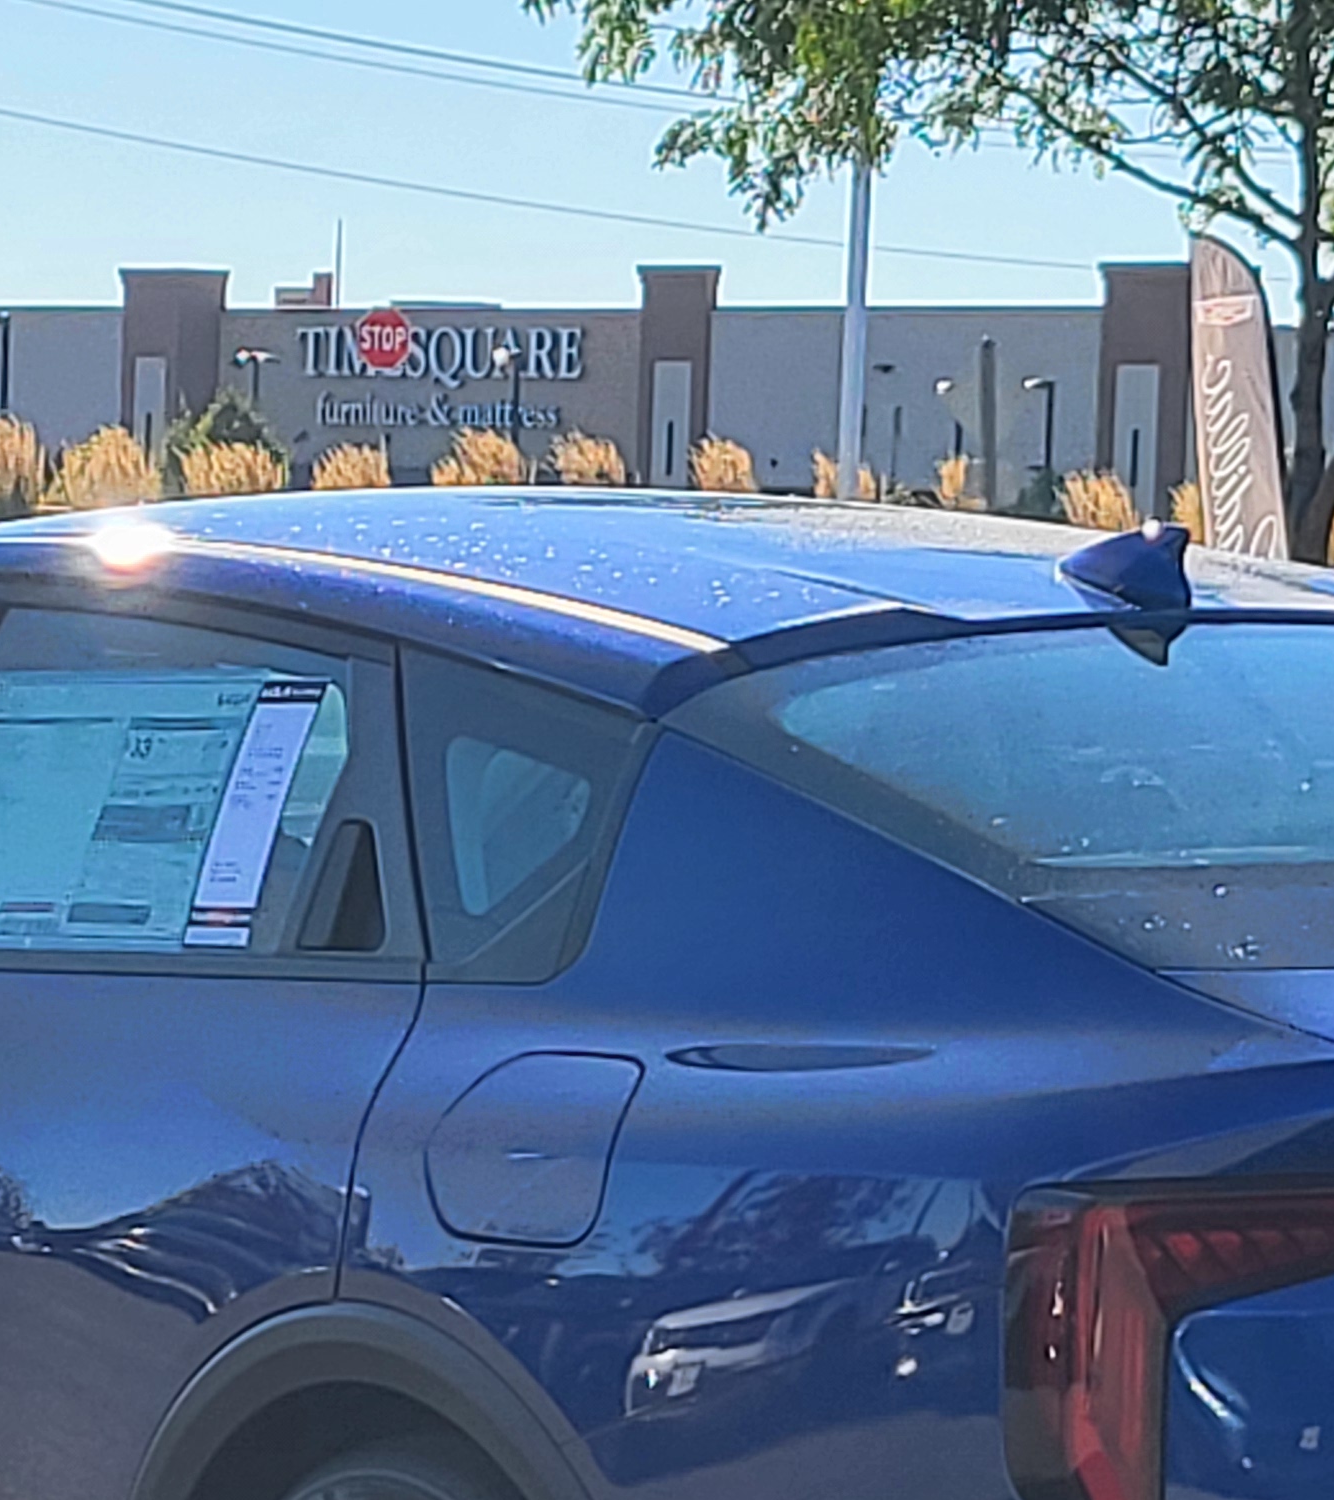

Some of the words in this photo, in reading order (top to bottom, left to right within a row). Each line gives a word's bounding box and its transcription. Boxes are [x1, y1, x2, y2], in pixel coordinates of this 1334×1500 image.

[360, 325, 408, 352] STOP
[297, 325, 585, 389] TIMSQUARE
[427, 391, 451, 427] &
